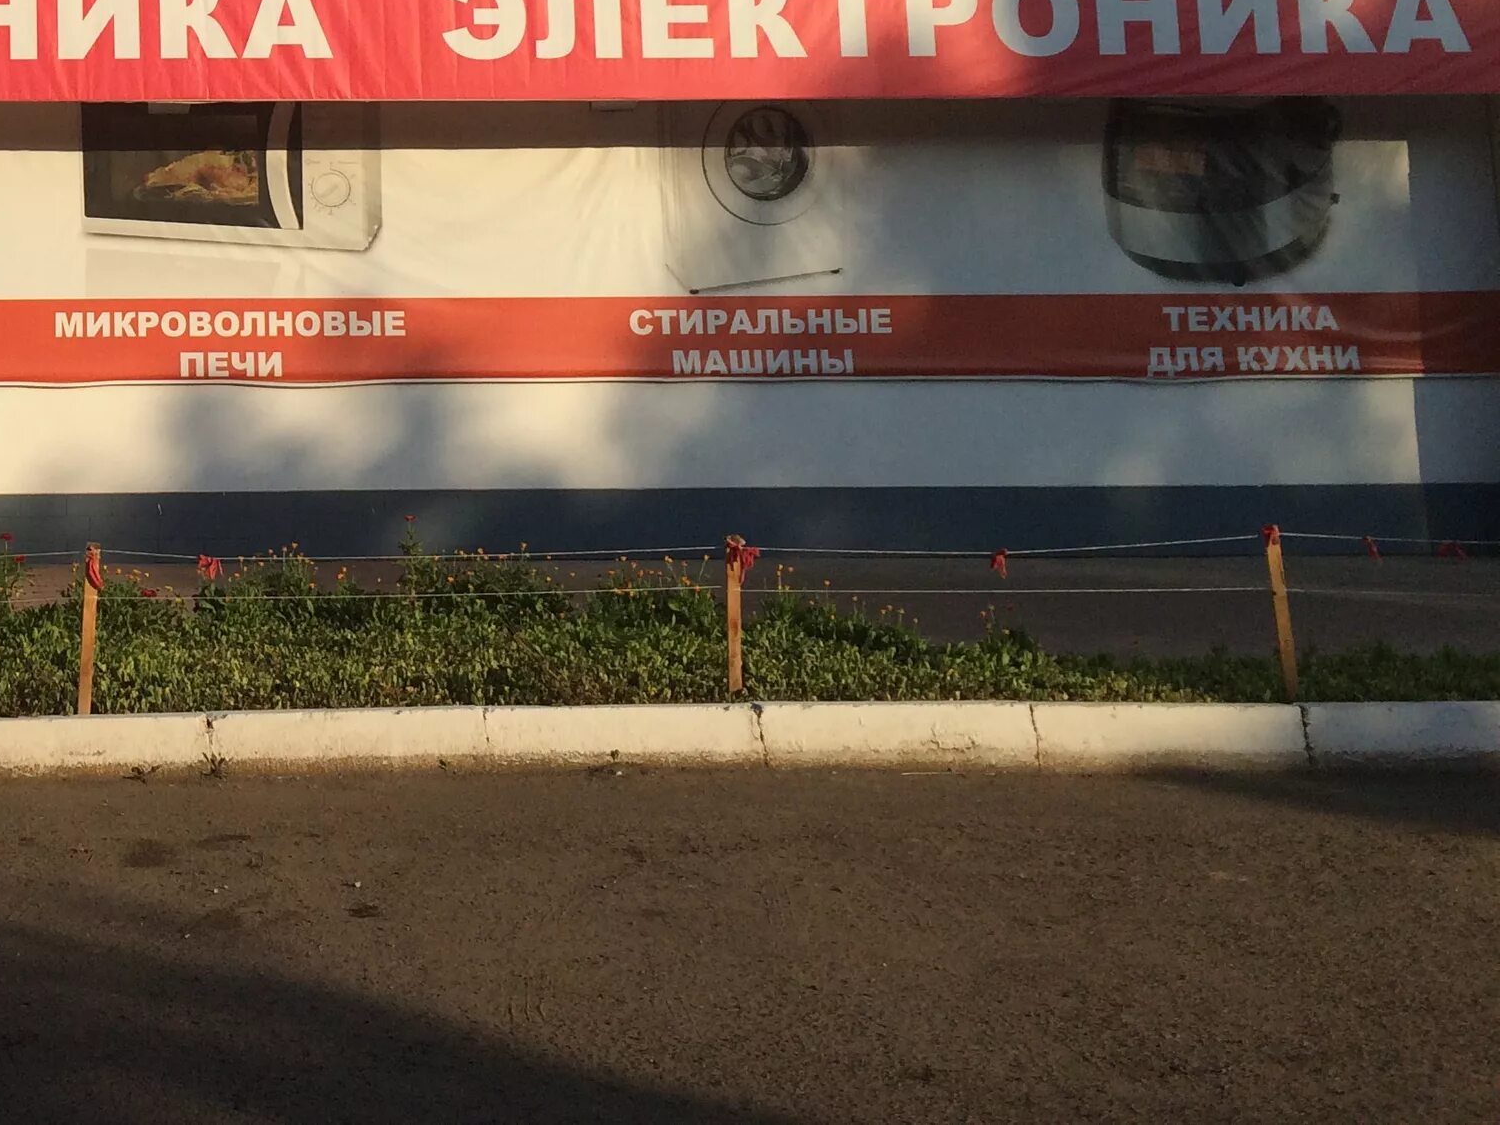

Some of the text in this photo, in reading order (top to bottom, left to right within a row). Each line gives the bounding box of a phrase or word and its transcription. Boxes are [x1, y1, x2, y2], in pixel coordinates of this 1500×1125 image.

[54, 310, 407, 338] МИКРОВОЛНОВЫЕ
[628, 308, 893, 336] СТИРАЛЬНЫЕ
[1162, 306, 1340, 332] ТЕХНИКА
[179, 351, 284, 378] ПЕЧИ
[671, 349, 855, 375] МАШИНЫ
[1146, 346, 1362, 377] ДЛЯ КУХНИ
